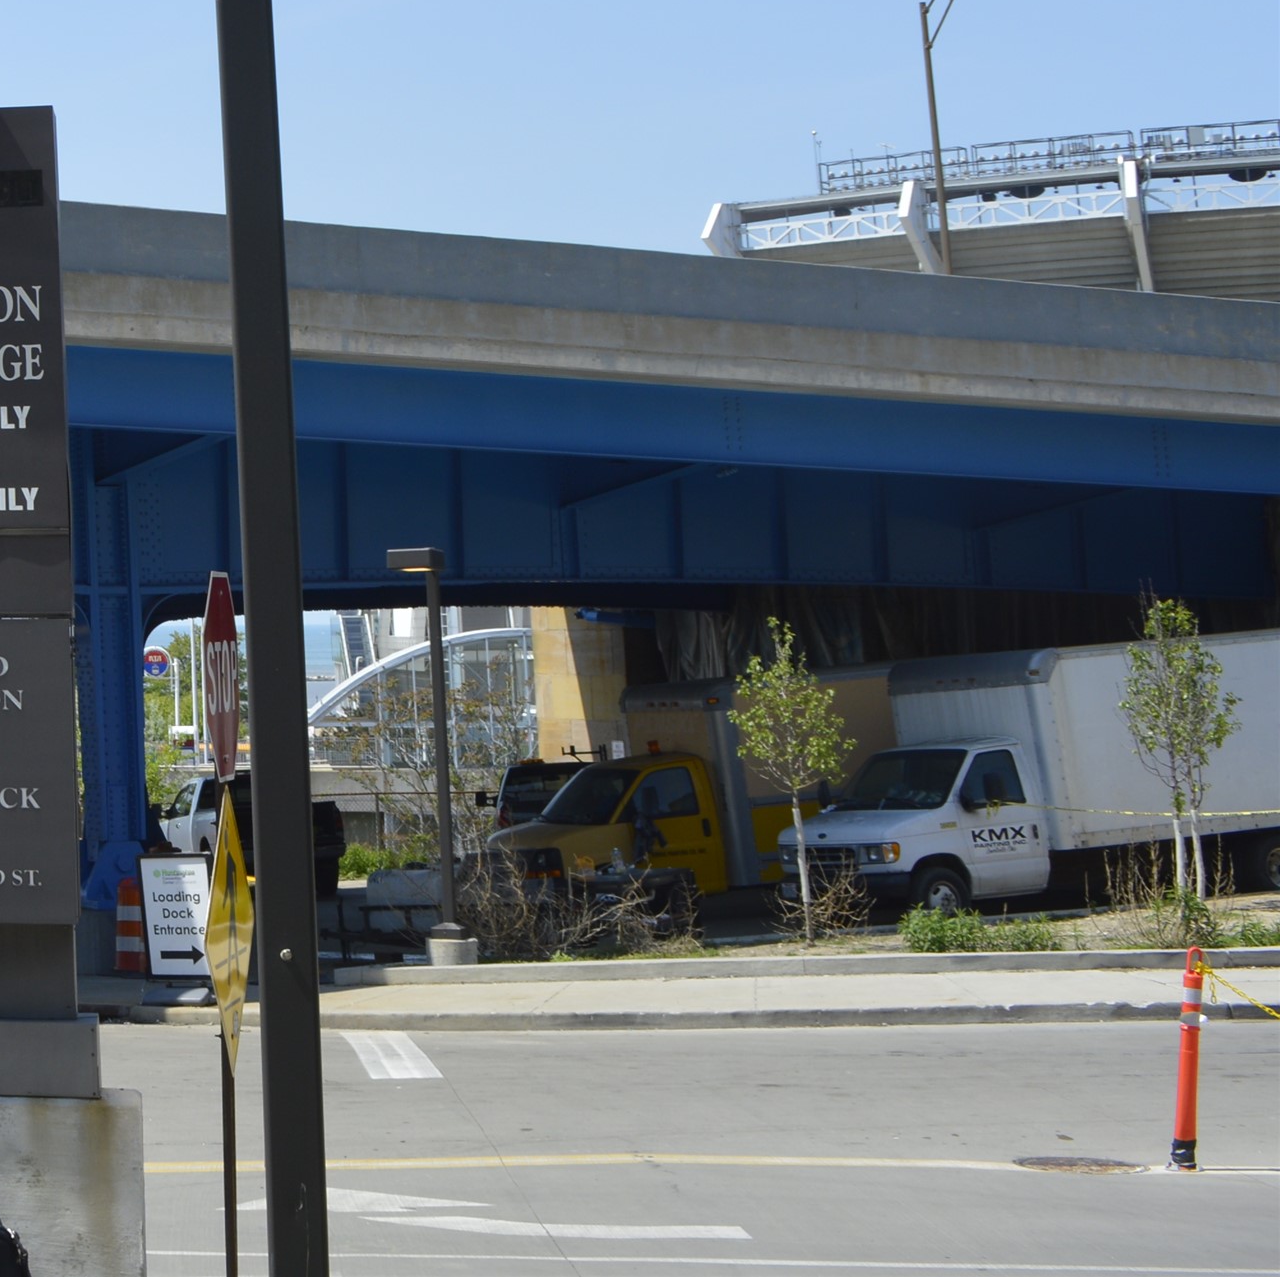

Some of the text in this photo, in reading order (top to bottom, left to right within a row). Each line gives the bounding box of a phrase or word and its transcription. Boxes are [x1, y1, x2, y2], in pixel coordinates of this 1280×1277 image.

[206, 639, 237, 716] STOP
[971, 826, 1027, 843] KMX
[974, 840, 1011, 849] PAINTING
[12, 869, 43, 886] ST.
[152, 891, 201, 904] Loading
[162, 907, 194, 919] Dock
[153, 924, 205, 935] Entrance
